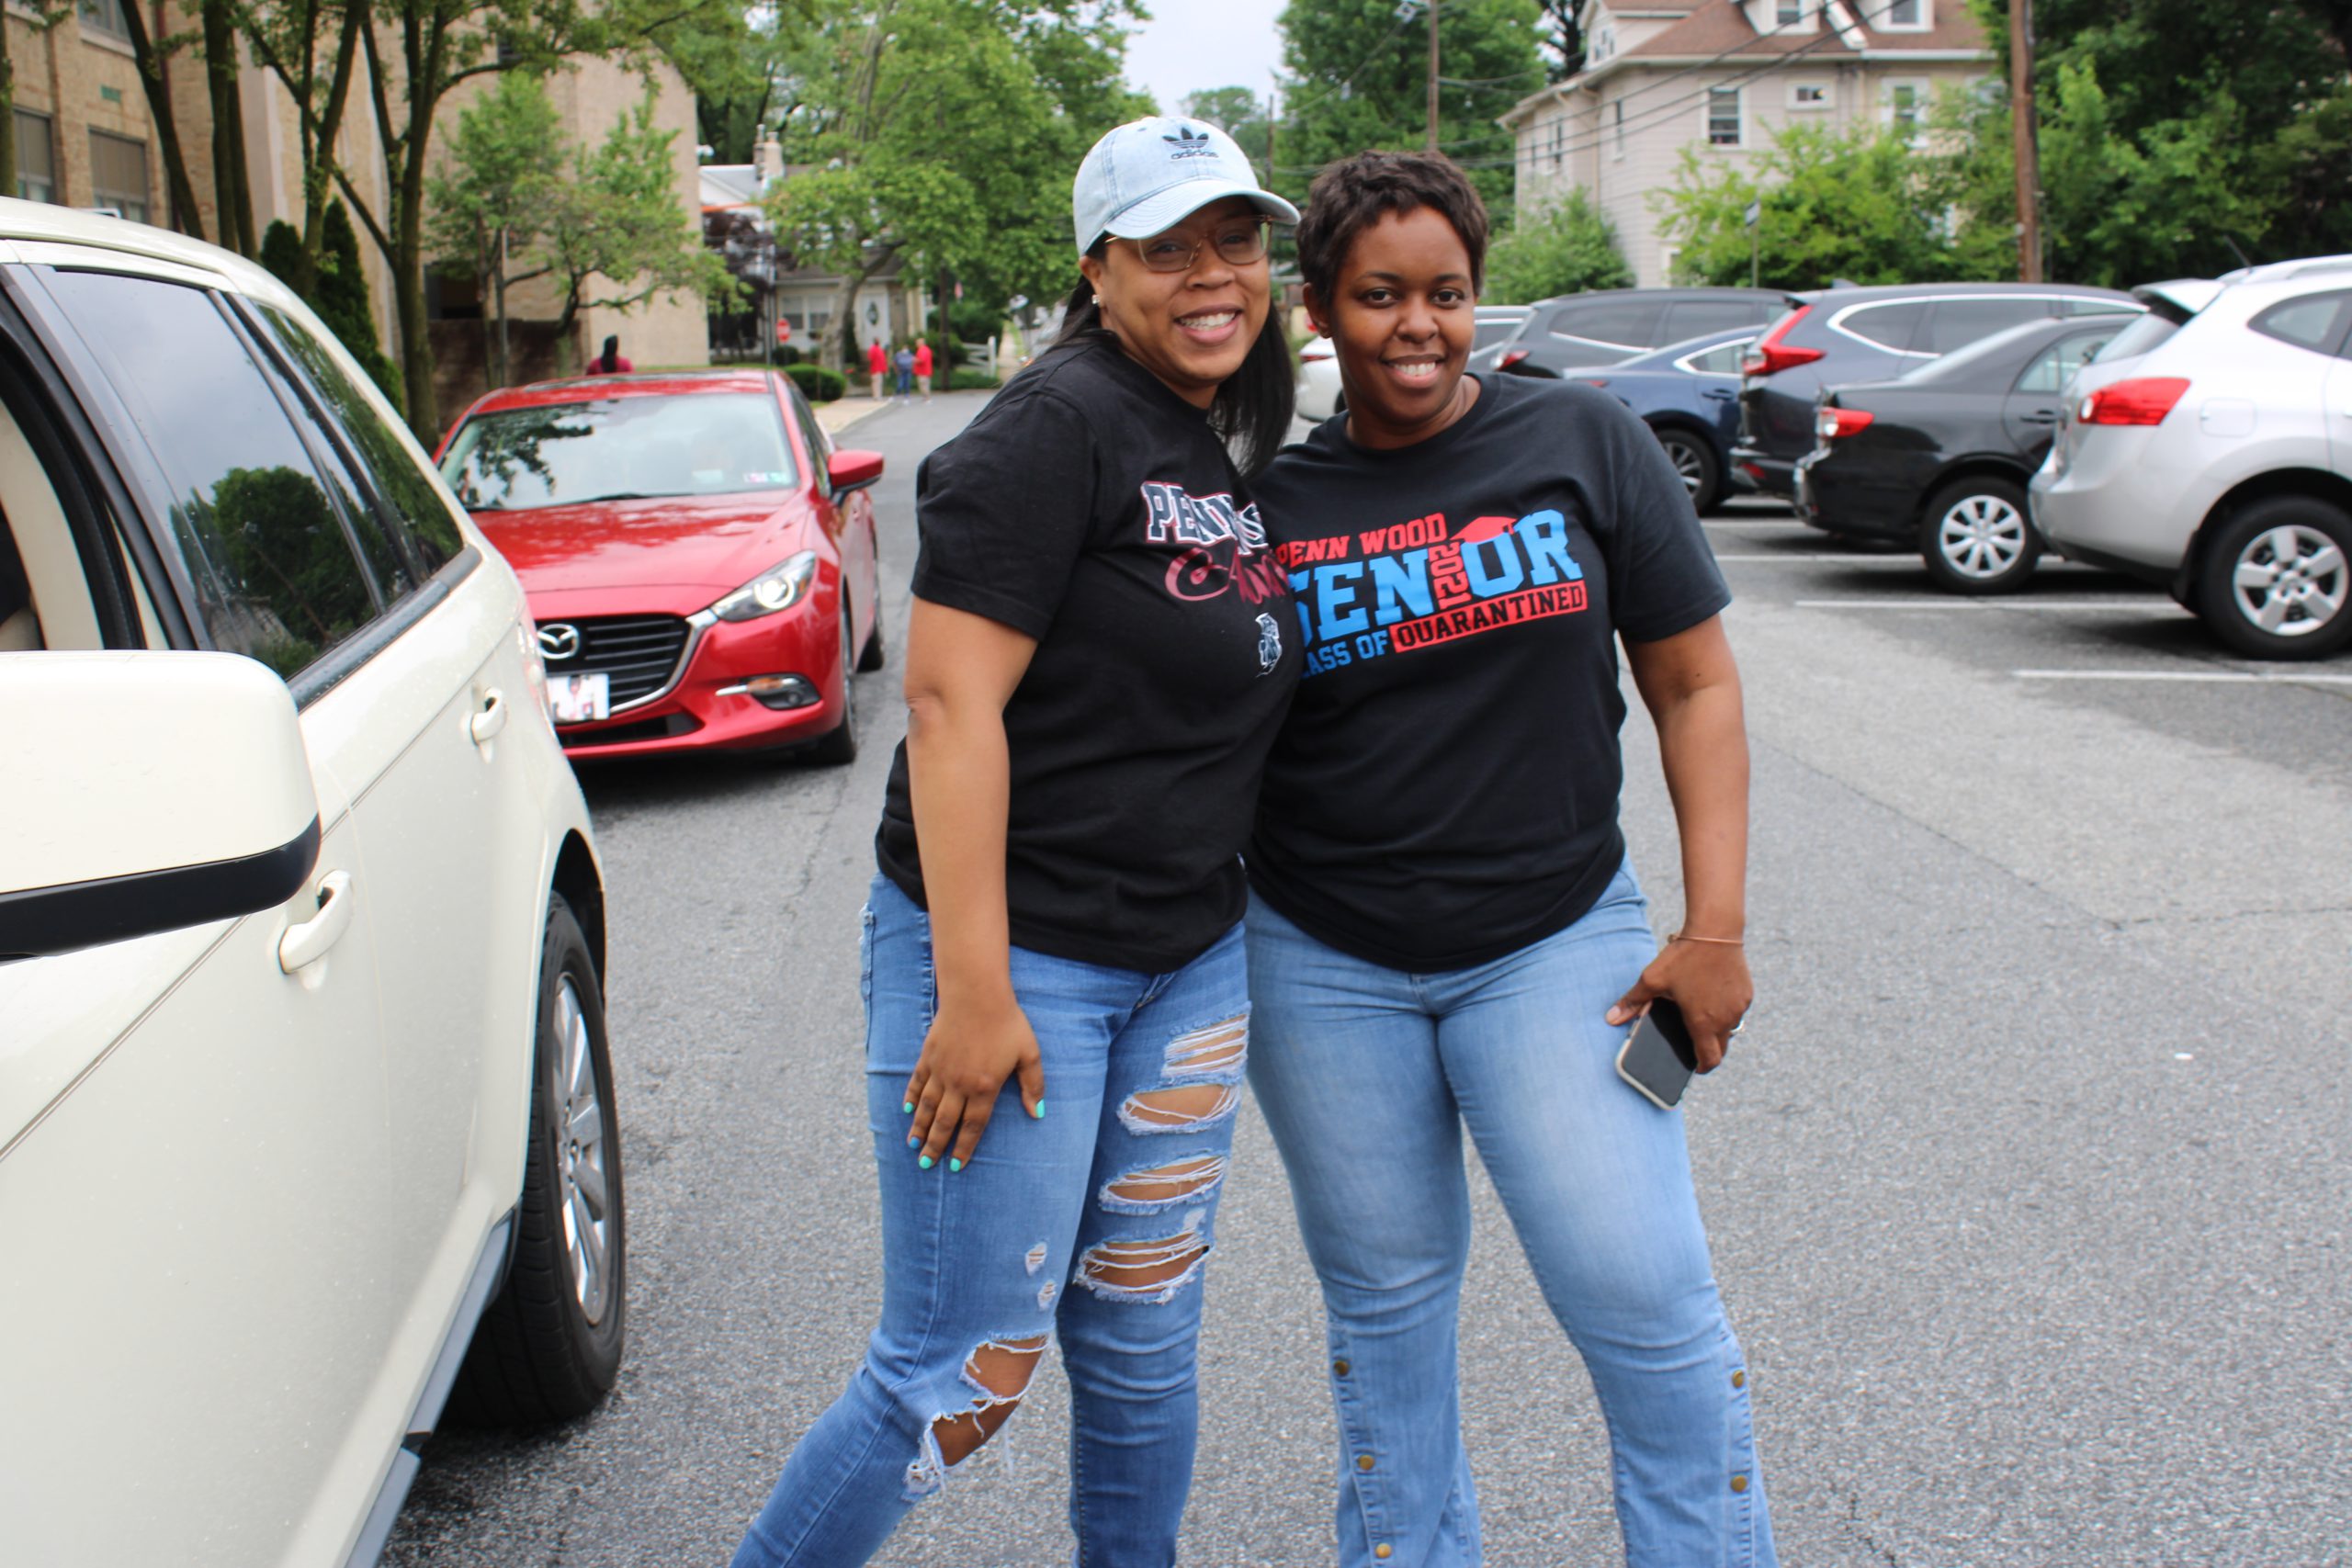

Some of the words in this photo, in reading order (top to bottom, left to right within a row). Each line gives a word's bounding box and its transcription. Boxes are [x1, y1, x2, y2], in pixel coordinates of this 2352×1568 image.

[1170, 149, 1219, 160] adidas
[1359, 513, 1448, 556] WOOD
[1428, 541, 1472, 610] 2021
[1355, 629, 1388, 660] OF
[1396, 585, 1584, 648] QUARANTINED
